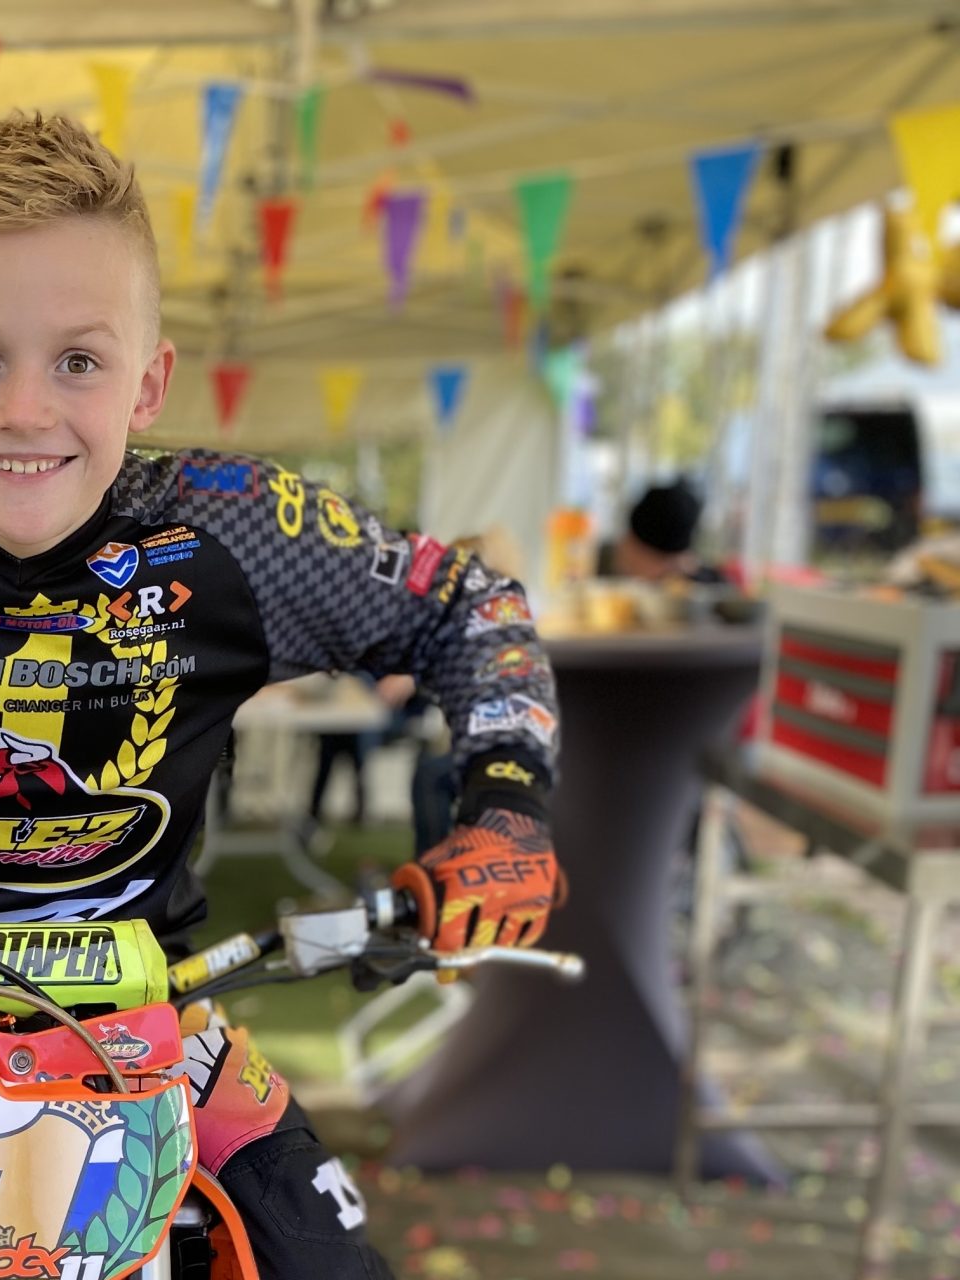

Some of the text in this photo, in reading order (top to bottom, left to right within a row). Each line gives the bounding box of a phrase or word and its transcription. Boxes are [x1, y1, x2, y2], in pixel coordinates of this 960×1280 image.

[110, 619, 186, 639] Rosegaar.nl
[3, 698, 82, 713] CHANGER
[88, 698, 104, 710] IN
[457, 858, 551, 887] DEFT
